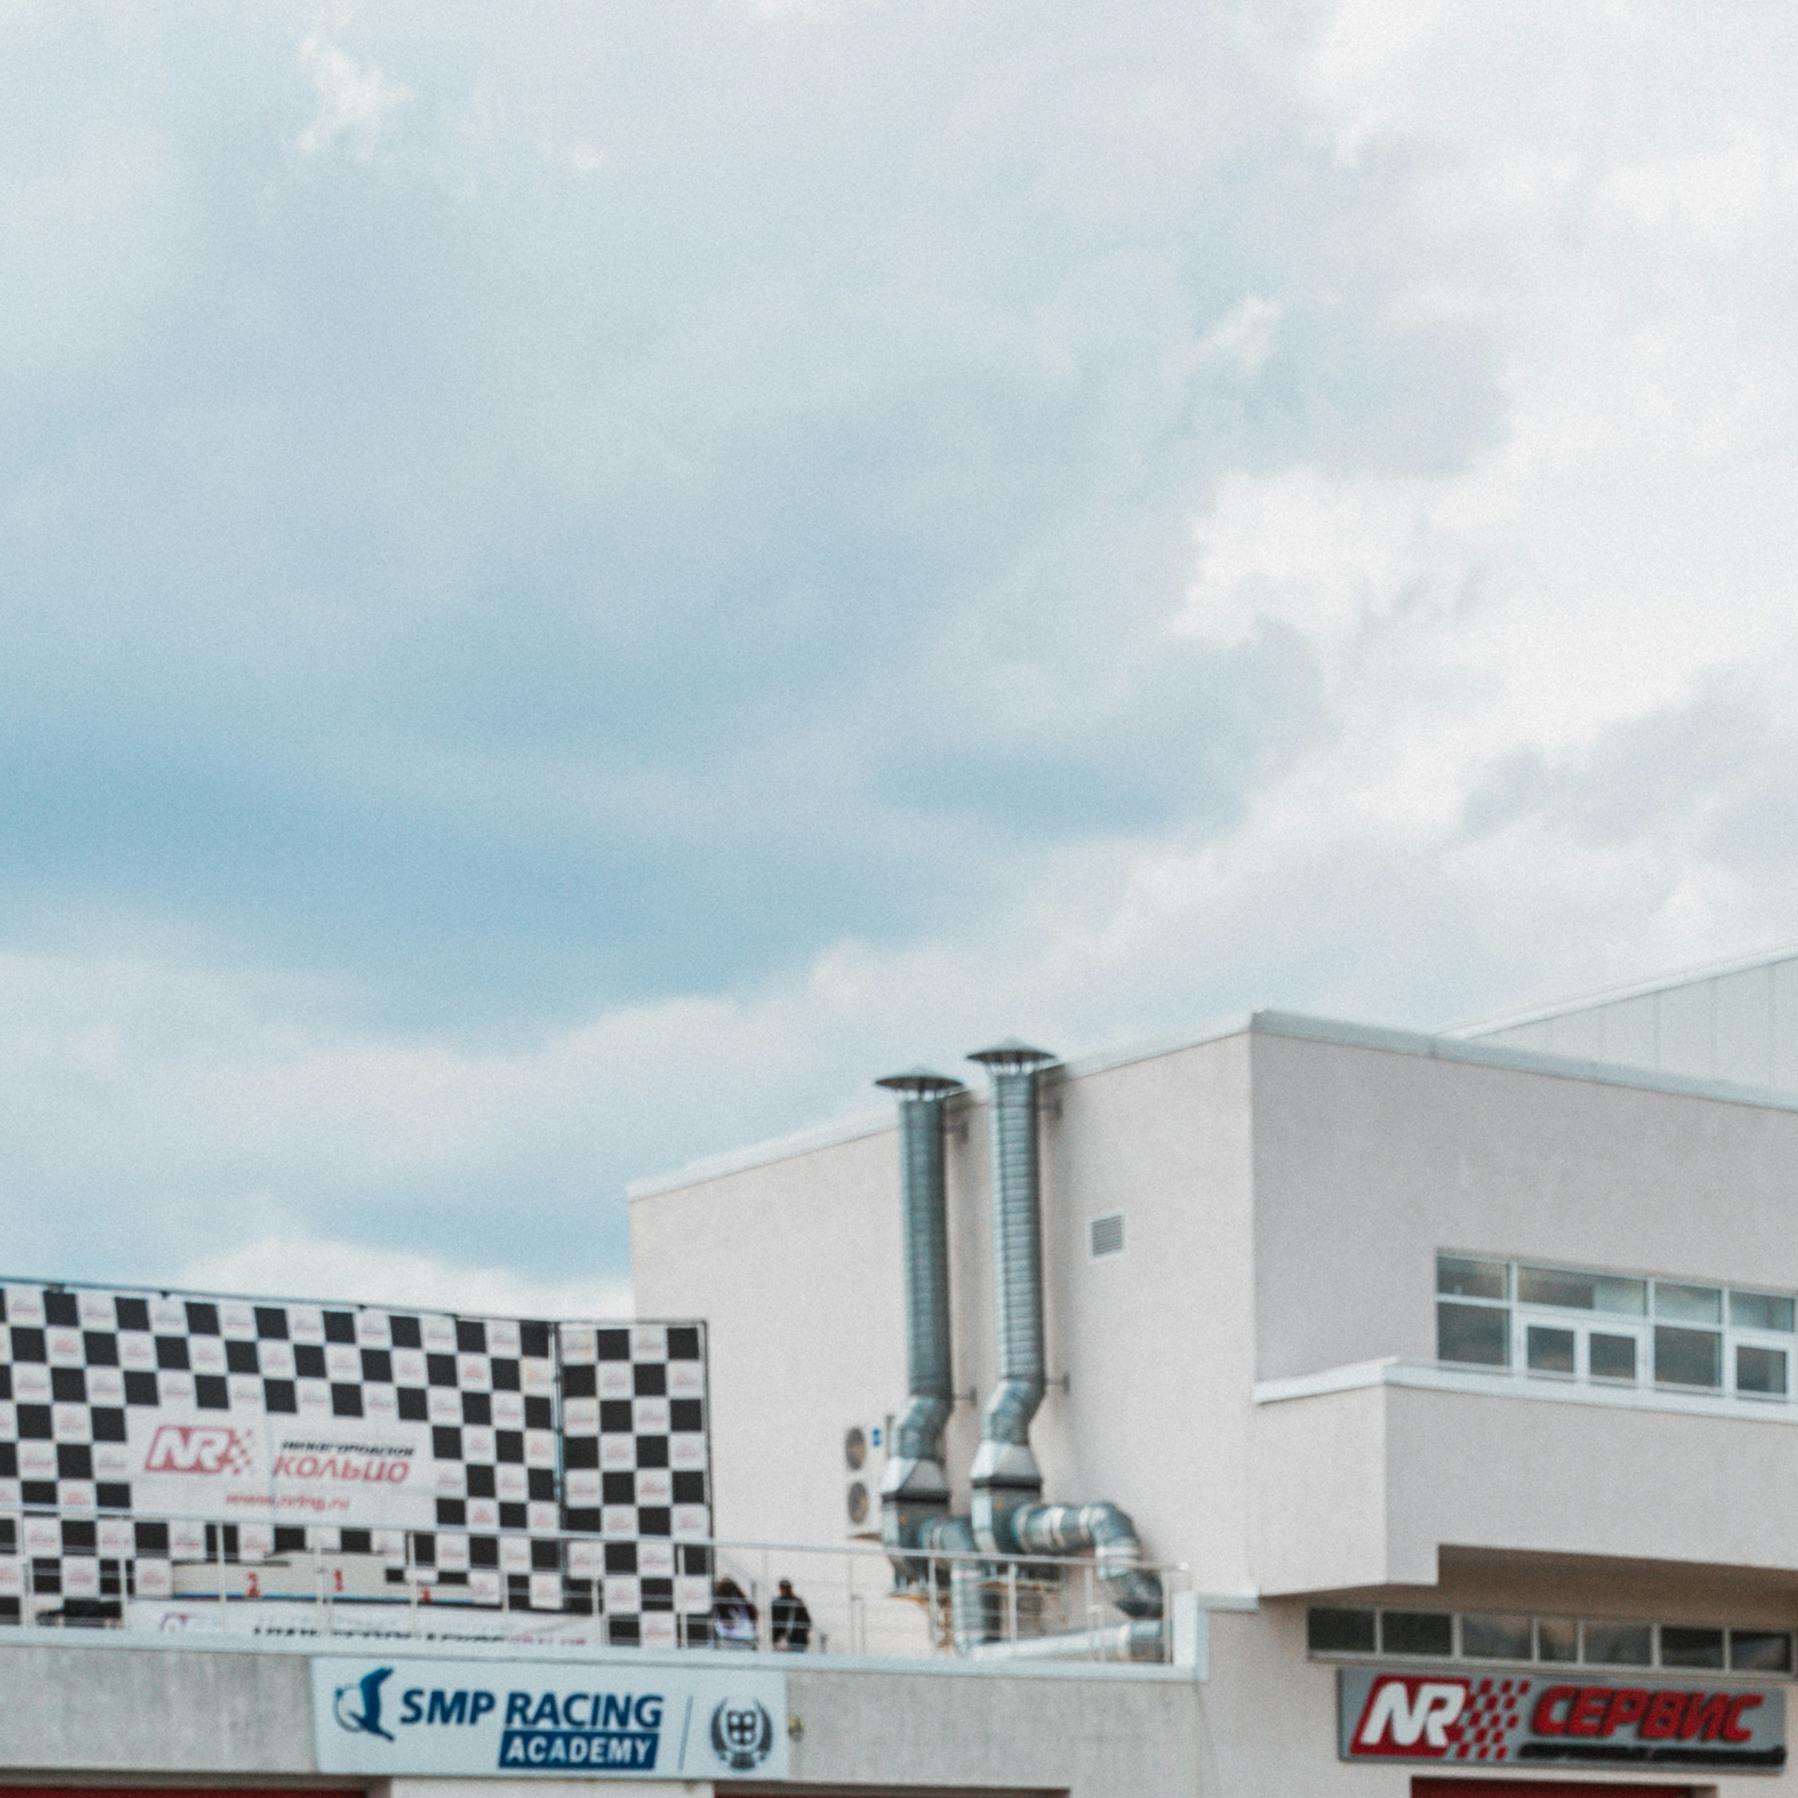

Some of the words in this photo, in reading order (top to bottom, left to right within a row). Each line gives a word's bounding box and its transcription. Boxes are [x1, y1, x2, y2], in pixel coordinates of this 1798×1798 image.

[273, 1454, 411, 1484] КОЛЬЦО
[400, 1688, 495, 1726] SMP
[504, 1690, 664, 1729] RACING
[1530, 1684, 1764, 1743] СЕРВИС
[505, 1736, 652, 1767] ACADEMY
